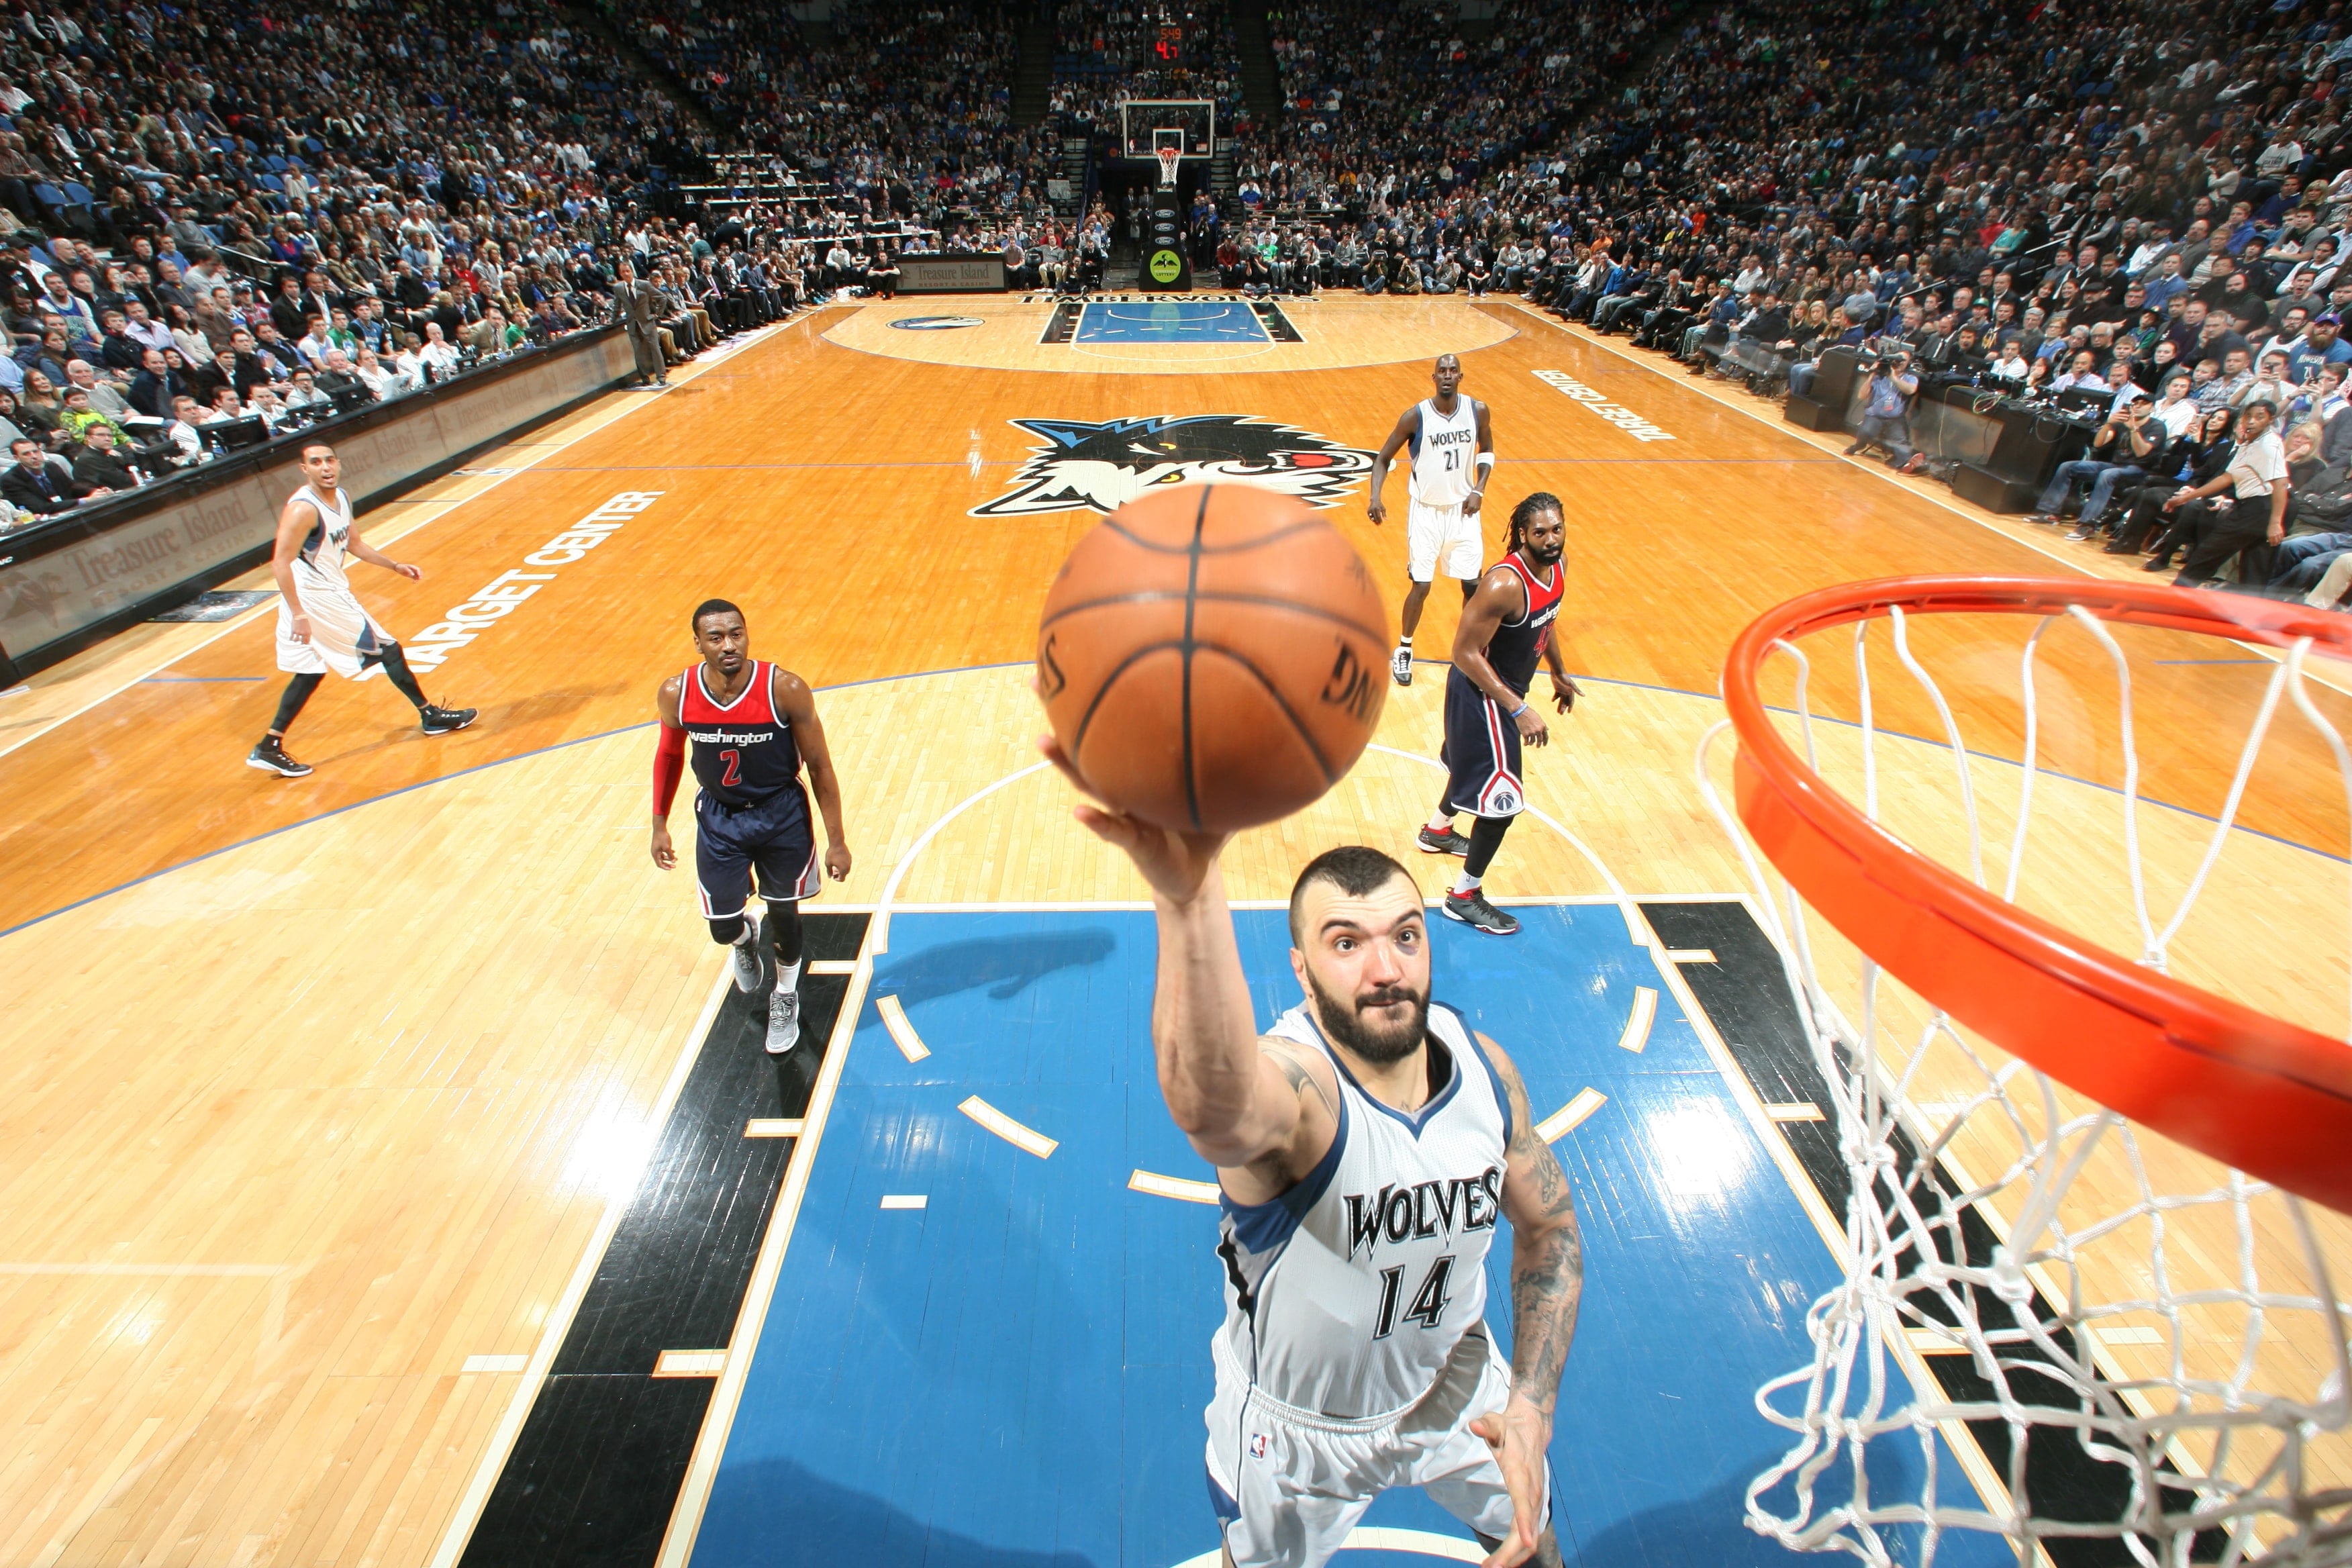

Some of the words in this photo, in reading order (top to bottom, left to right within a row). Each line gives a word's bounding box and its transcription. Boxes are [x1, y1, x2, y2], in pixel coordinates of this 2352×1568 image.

[916, 264, 957, 280] Treasure
[960, 262, 990, 279] Island
[1530, 369, 1608, 402] CENTER
[1581, 401, 1677, 442] TARGET
[1427, 429, 1471, 451] WOLVES
[1443, 448, 1460, 473] 21
[62, 525, 182, 590] Treasure
[176, 490, 250, 546] Island
[524, 491, 666, 565] CENTER
[1531, 602, 1561, 629] washing
[688, 728, 773, 746] washington
[720, 749, 742, 787] 2
[1342, 1167, 1501, 1263] WOLVES
[1373, 1255, 1456, 1340] 14
